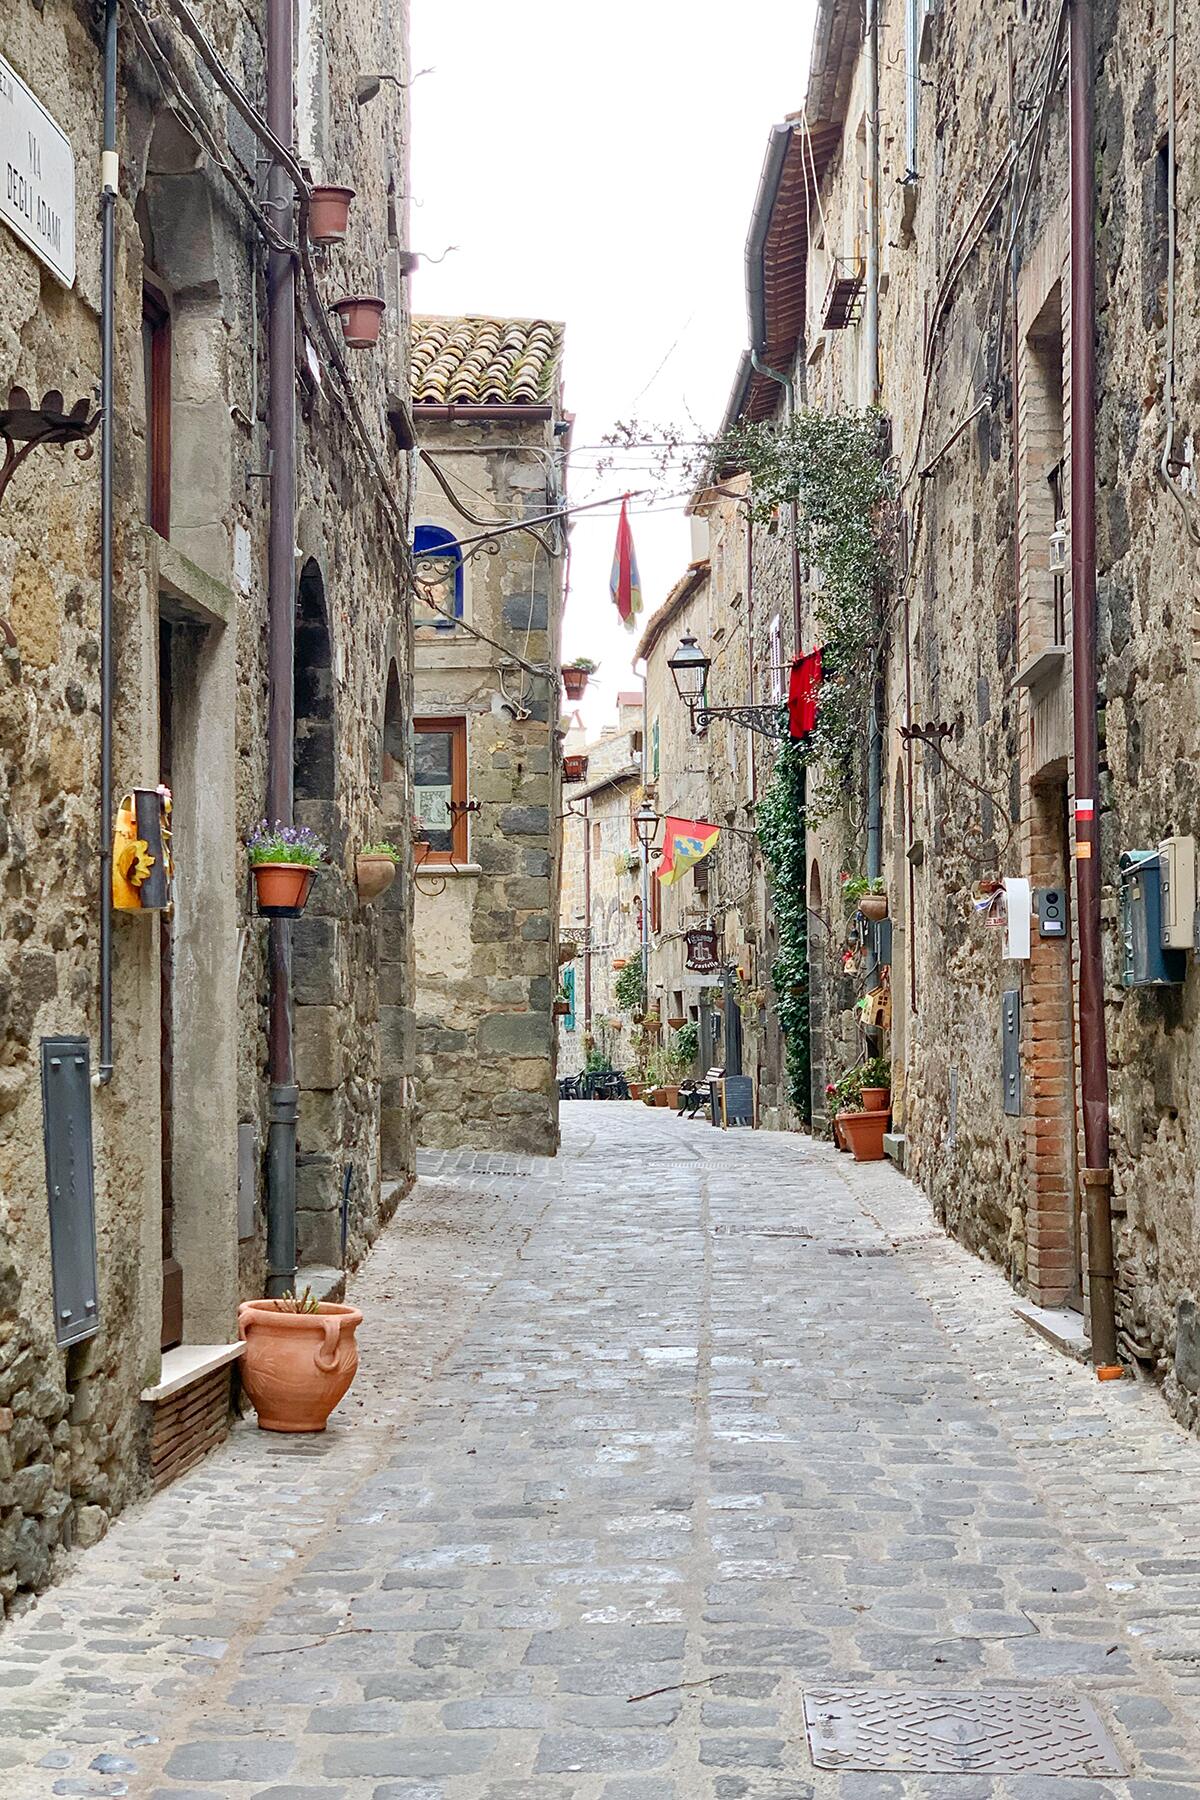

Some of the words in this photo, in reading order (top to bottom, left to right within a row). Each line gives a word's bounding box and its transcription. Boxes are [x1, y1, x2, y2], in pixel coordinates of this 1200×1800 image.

[28, 131, 41, 181] VIA
[7, 161, 33, 223] DEGLI
[36, 195, 61, 255] ADAMI
